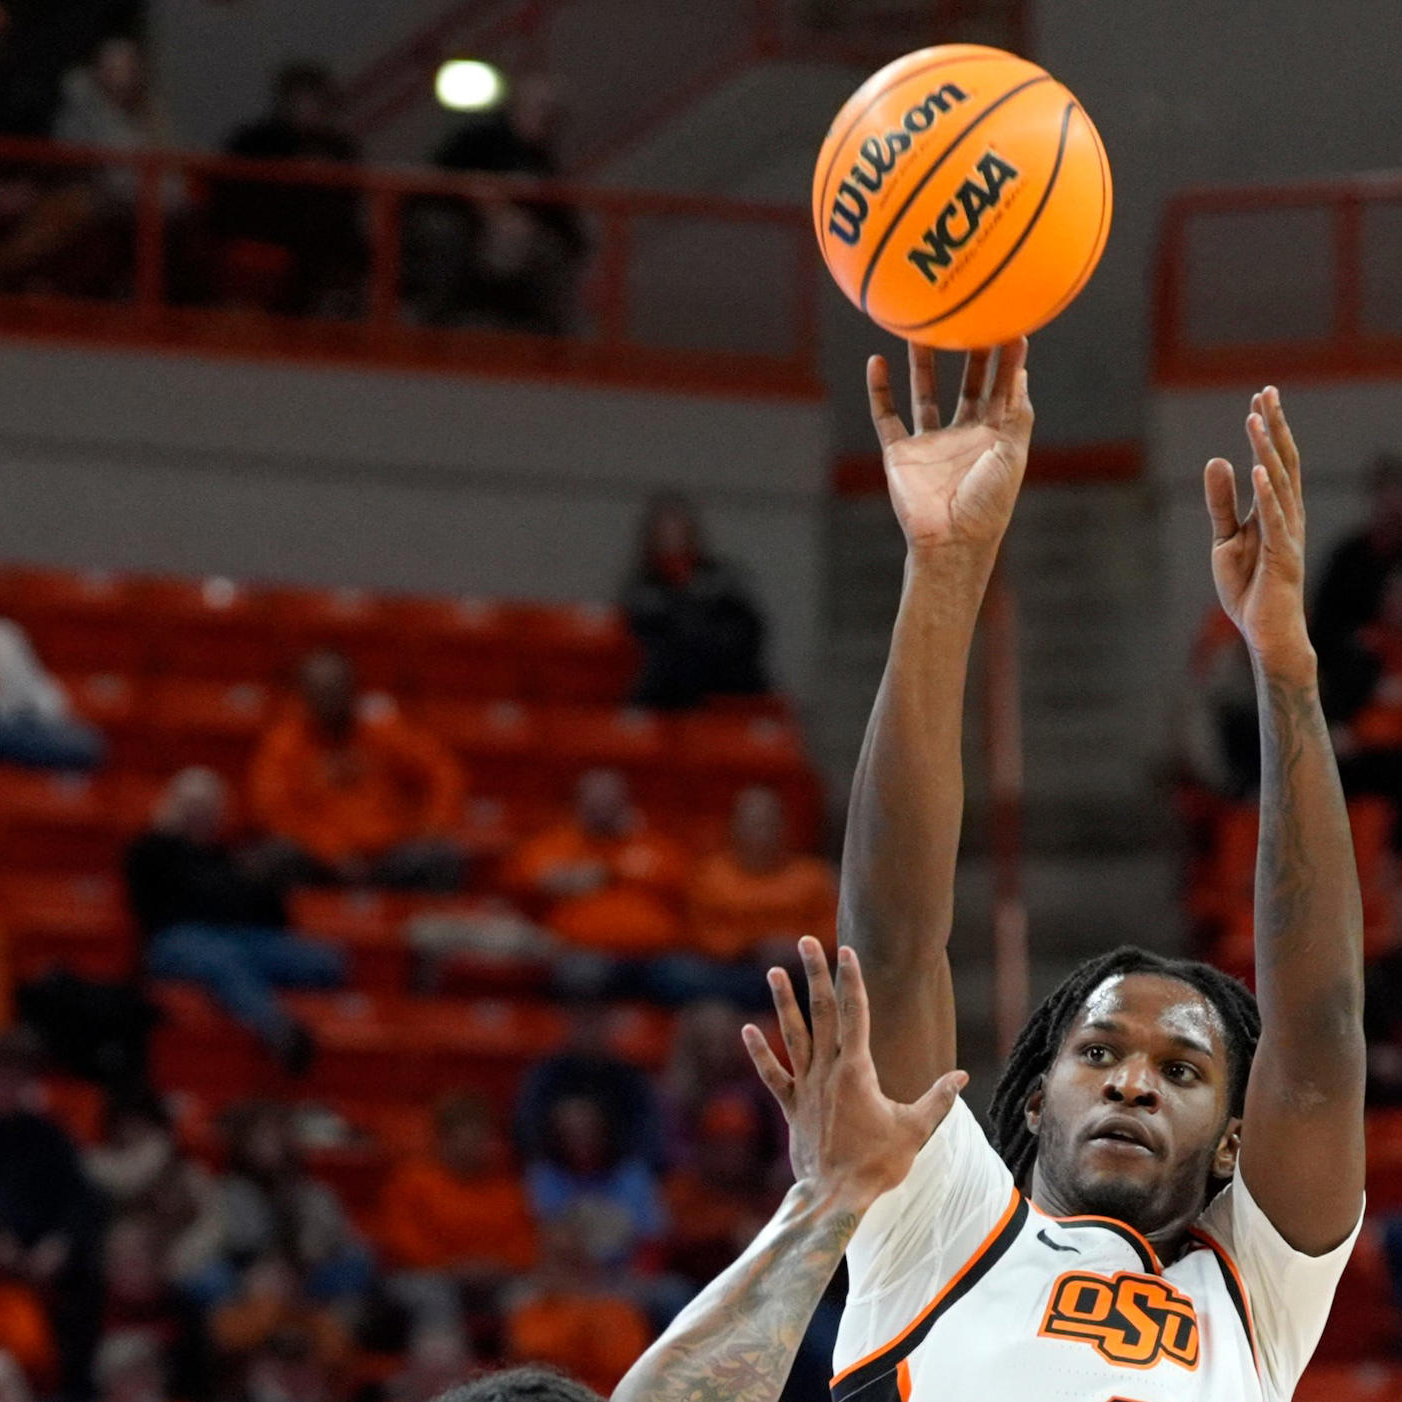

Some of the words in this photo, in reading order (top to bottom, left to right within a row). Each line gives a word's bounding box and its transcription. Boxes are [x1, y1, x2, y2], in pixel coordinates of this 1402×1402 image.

[829, 82, 969, 246] Wilson
[907, 151, 1018, 283] NCAA
[1037, 1270, 1200, 1372] OSU
